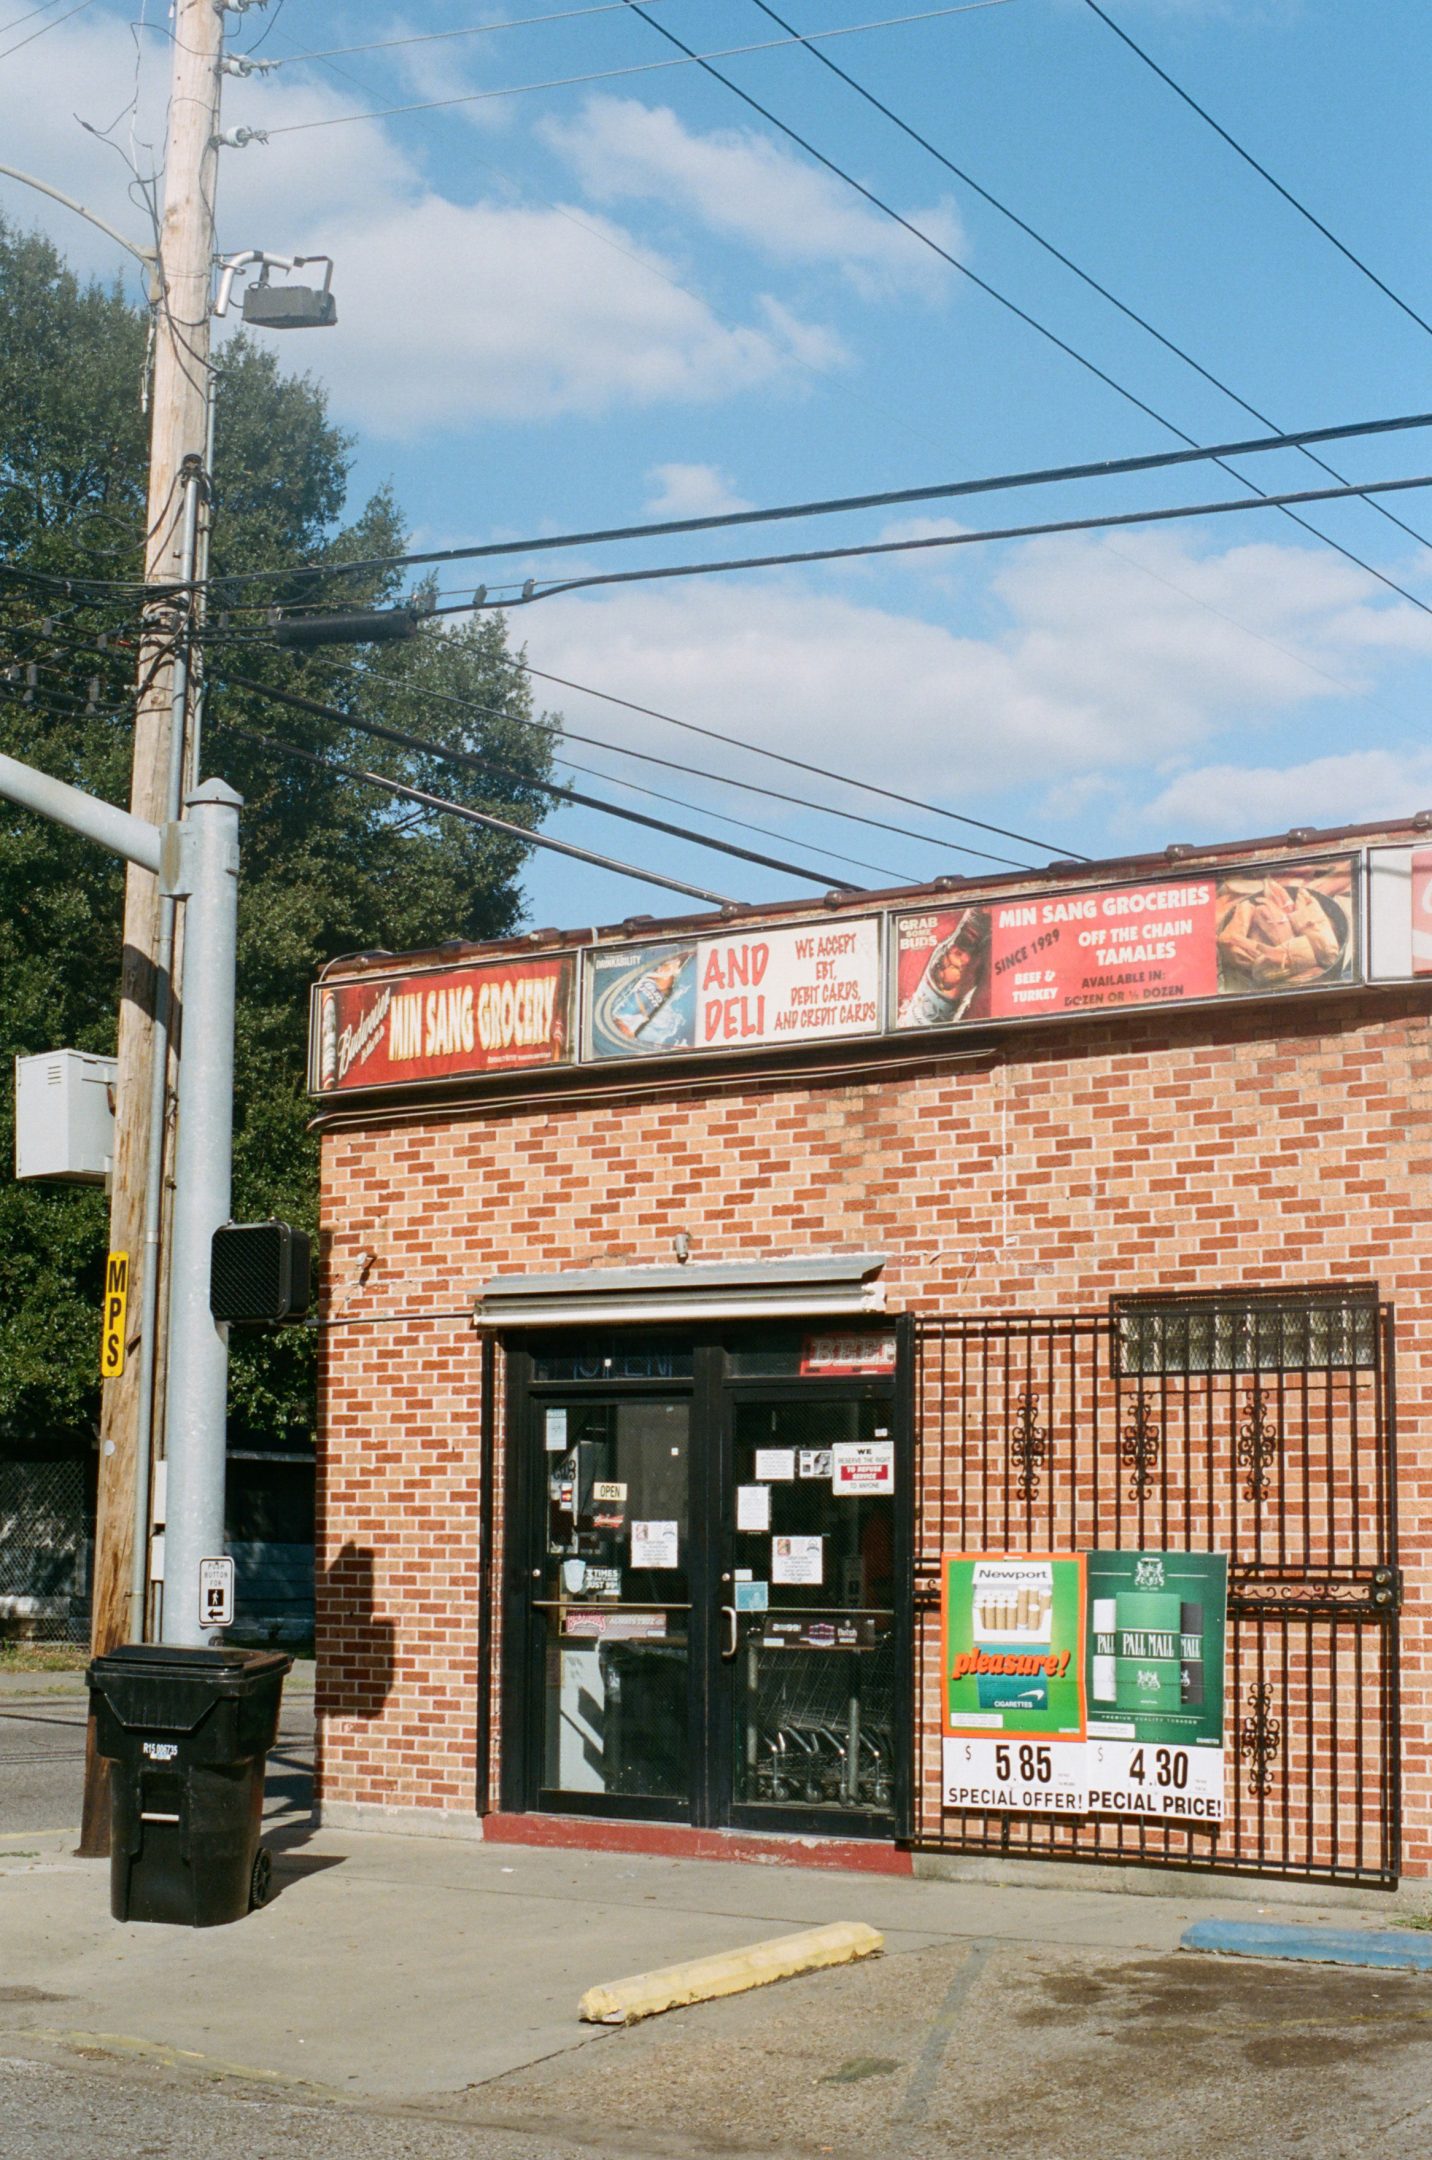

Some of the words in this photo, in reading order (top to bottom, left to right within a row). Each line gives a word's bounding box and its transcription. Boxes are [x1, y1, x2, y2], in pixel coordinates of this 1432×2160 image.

[999, 906, 1036, 929] MIN
[1041, 900, 1097, 923] SANG
[1103, 886, 1210, 915] GROCERIES
[900, 916, 938, 931] GRAB
[1078, 930, 1107, 947] OFF
[1110, 926, 1139, 943] THE
[1142, 919, 1193, 940] CHAIN
[795, 939, 814, 959] WE
[817, 933, 857, 957] ACCEPT
[901, 935, 938, 950] BUDS
[1096, 941, 1177, 966] TAMALES
[703, 943, 769, 991] AND
[816, 961, 837, 981] EBT,
[994, 948, 1028, 976] SINCE
[1014, 971, 1042, 986] BEEF
[1044, 970, 1056, 983] &
[1081, 971, 1145, 990] AVAILABLE
[1148, 970, 1166, 982] IN:
[791, 986, 819, 1006] DEBIT
[822, 980, 862, 1003] CARDS,
[1012, 988, 1059, 1004] TURKEY
[1064, 992, 1104, 1007] DOZEN
[1107, 990, 1125, 1003] OR
[1142, 985, 1184, 999] DOZEN
[388, 992, 423, 1061] MIN
[426, 985, 475, 1057] SANG
[478, 976, 557, 1050] GROCERY
[705, 995, 766, 1042] DELI
[775, 1011, 798, 1031] AND
[800, 1007, 837, 1028] CREDIT
[839, 1001, 876, 1024] CARDS
[106, 1260, 126, 1367] MPS
[600, 1485, 620, 1498] OPEN
[978, 1569, 1048, 1579] Newport
[1122, 1633, 1145, 1656] PALL
[1148, 1634, 1174, 1657] MALL
[952, 1647, 1071, 1680] pleasure!
[994, 1700, 1033, 1709] CIGARETTES
[965, 1745, 972, 1760] $
[996, 1744, 1052, 1783] 5.85
[1129, 1747, 1189, 1789] 4.30
[948, 1787, 1018, 1806] SPECIAL
[1022, 1791, 1083, 1809] OFFER!
[1088, 1790, 1157, 1812] PECIAL
[1163, 1795, 1222, 1818] PRICE!
